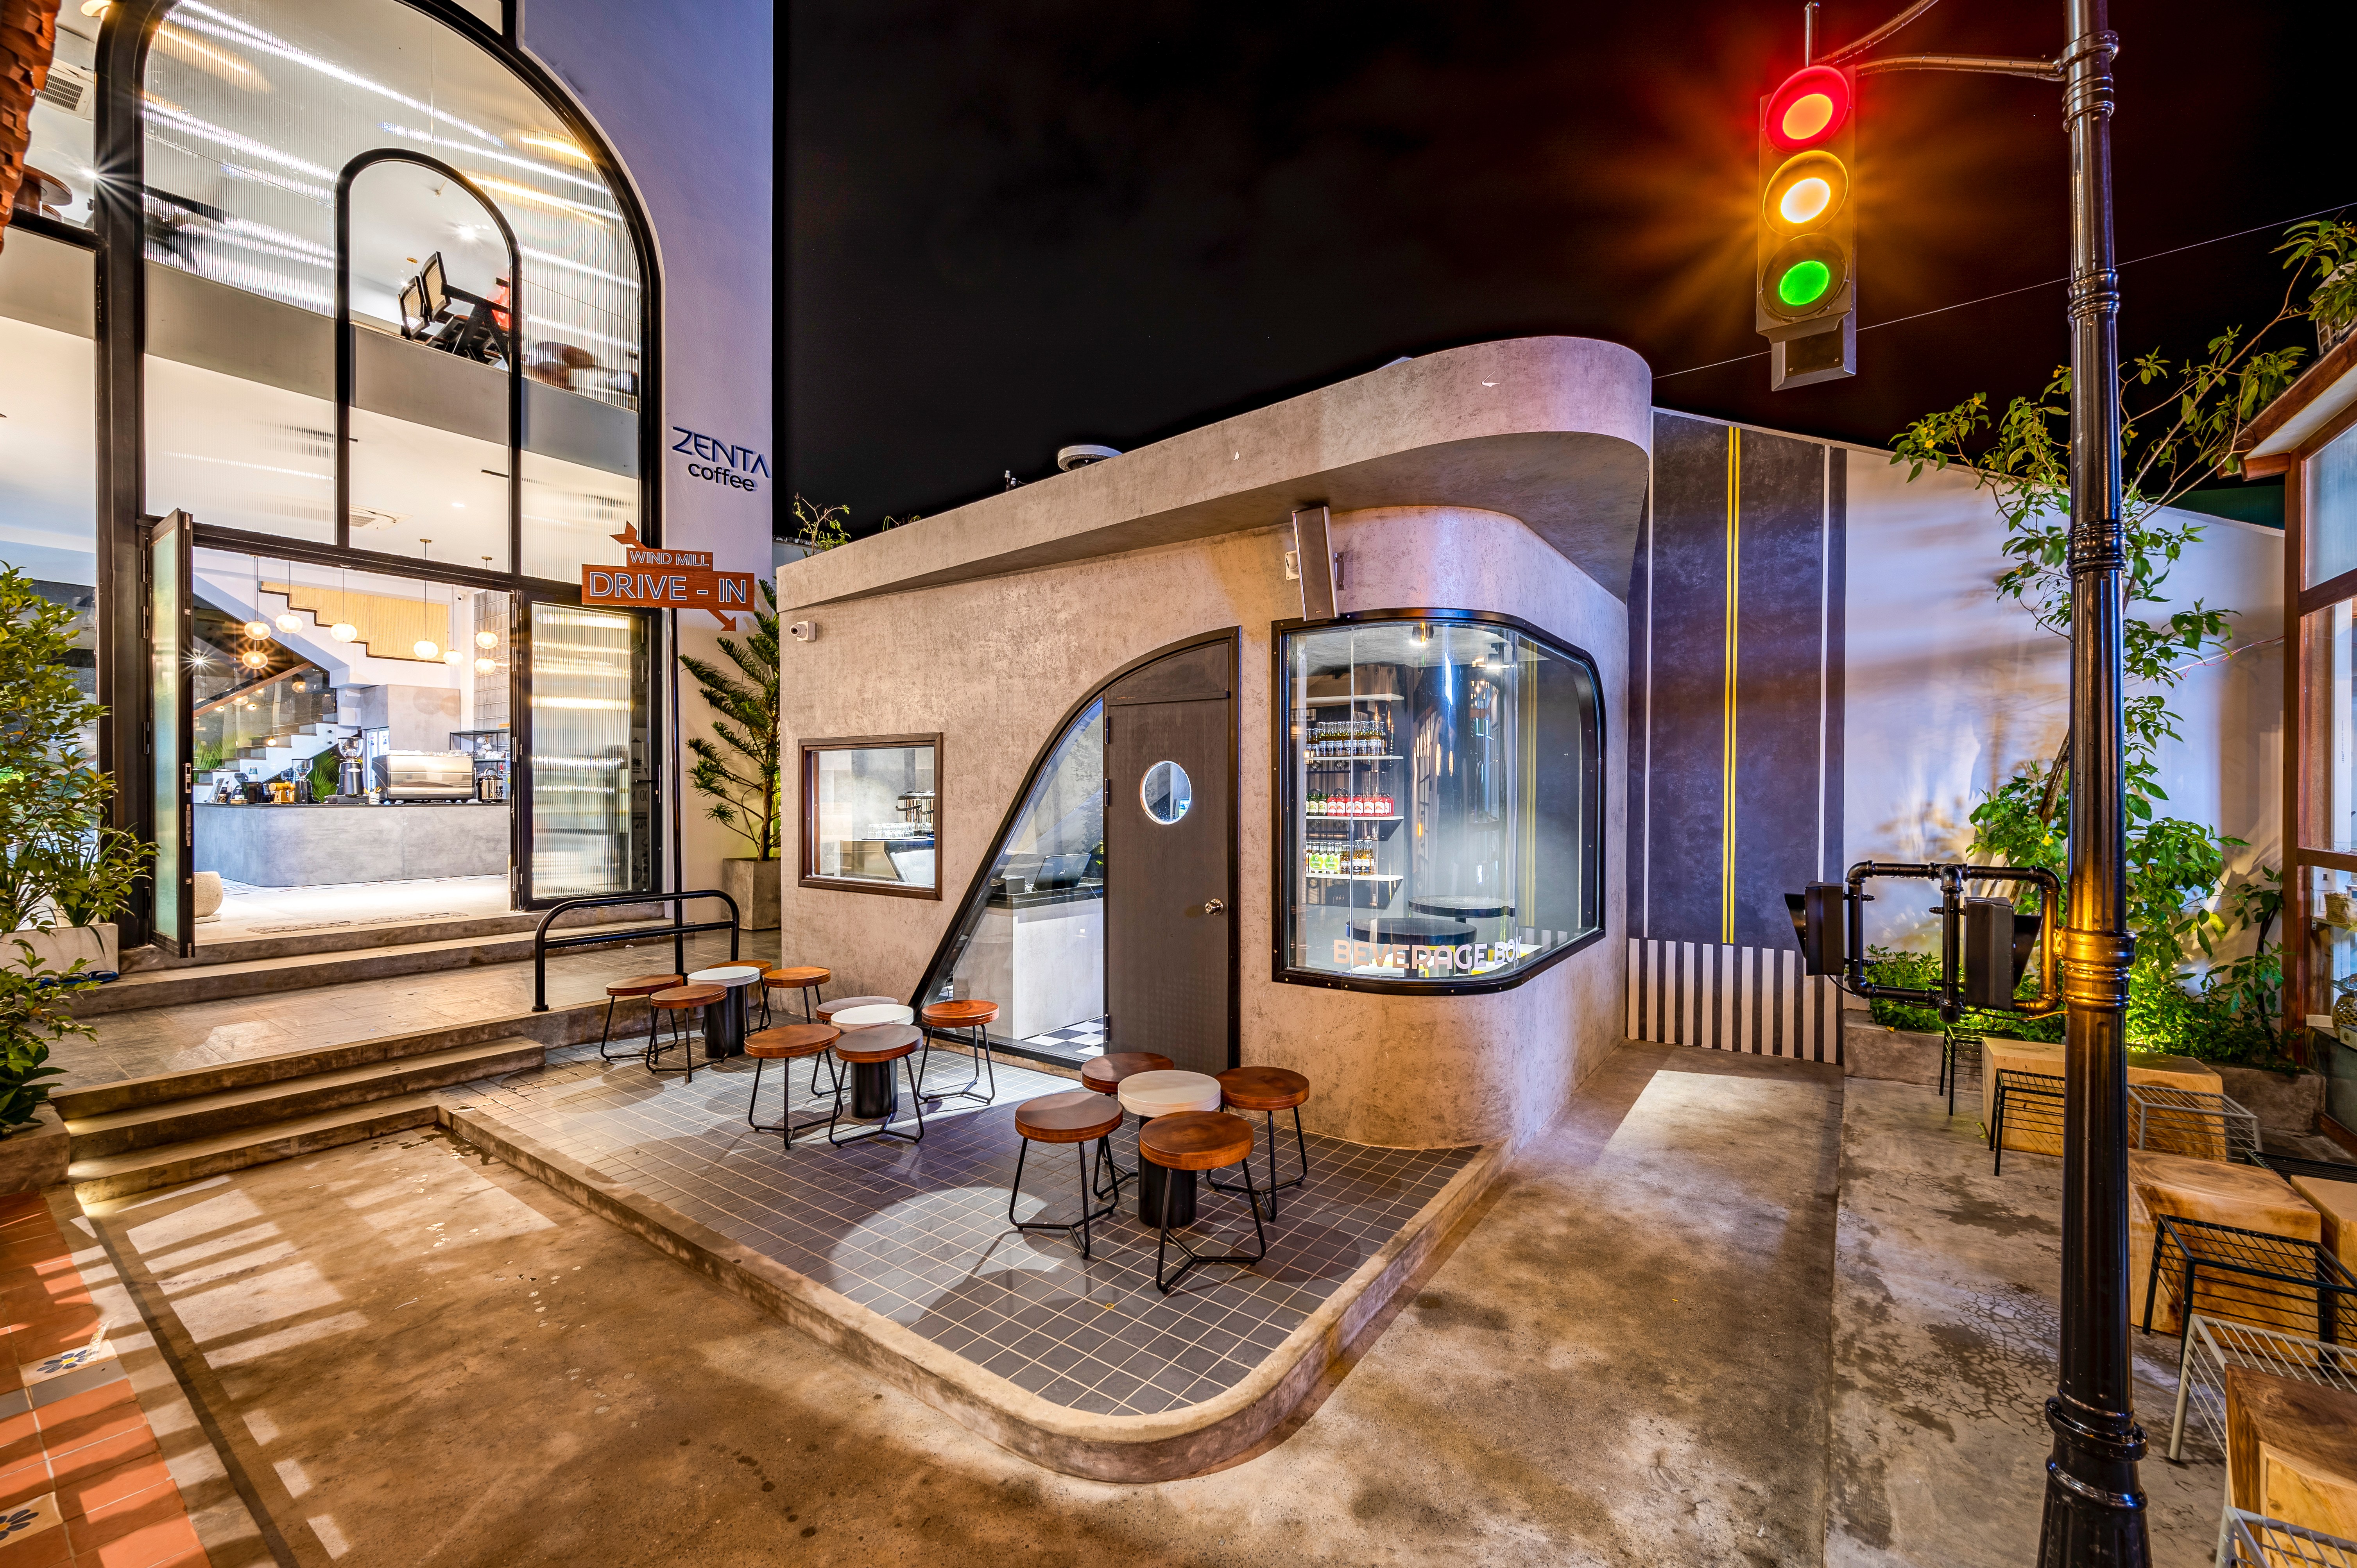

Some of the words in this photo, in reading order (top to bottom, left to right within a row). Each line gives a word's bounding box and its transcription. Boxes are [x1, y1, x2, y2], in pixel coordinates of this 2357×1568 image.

[672, 426, 770, 478] ZENTA
[688, 463, 755, 492] coffee
[629, 551, 672, 565] WIND
[675, 553, 709, 567] MILL
[589, 571, 687, 601] DRIVE
[719, 578, 746, 603] IN
[1333, 939, 1488, 970] BEVERAGE
[1494, 936, 1522, 965] BOX
